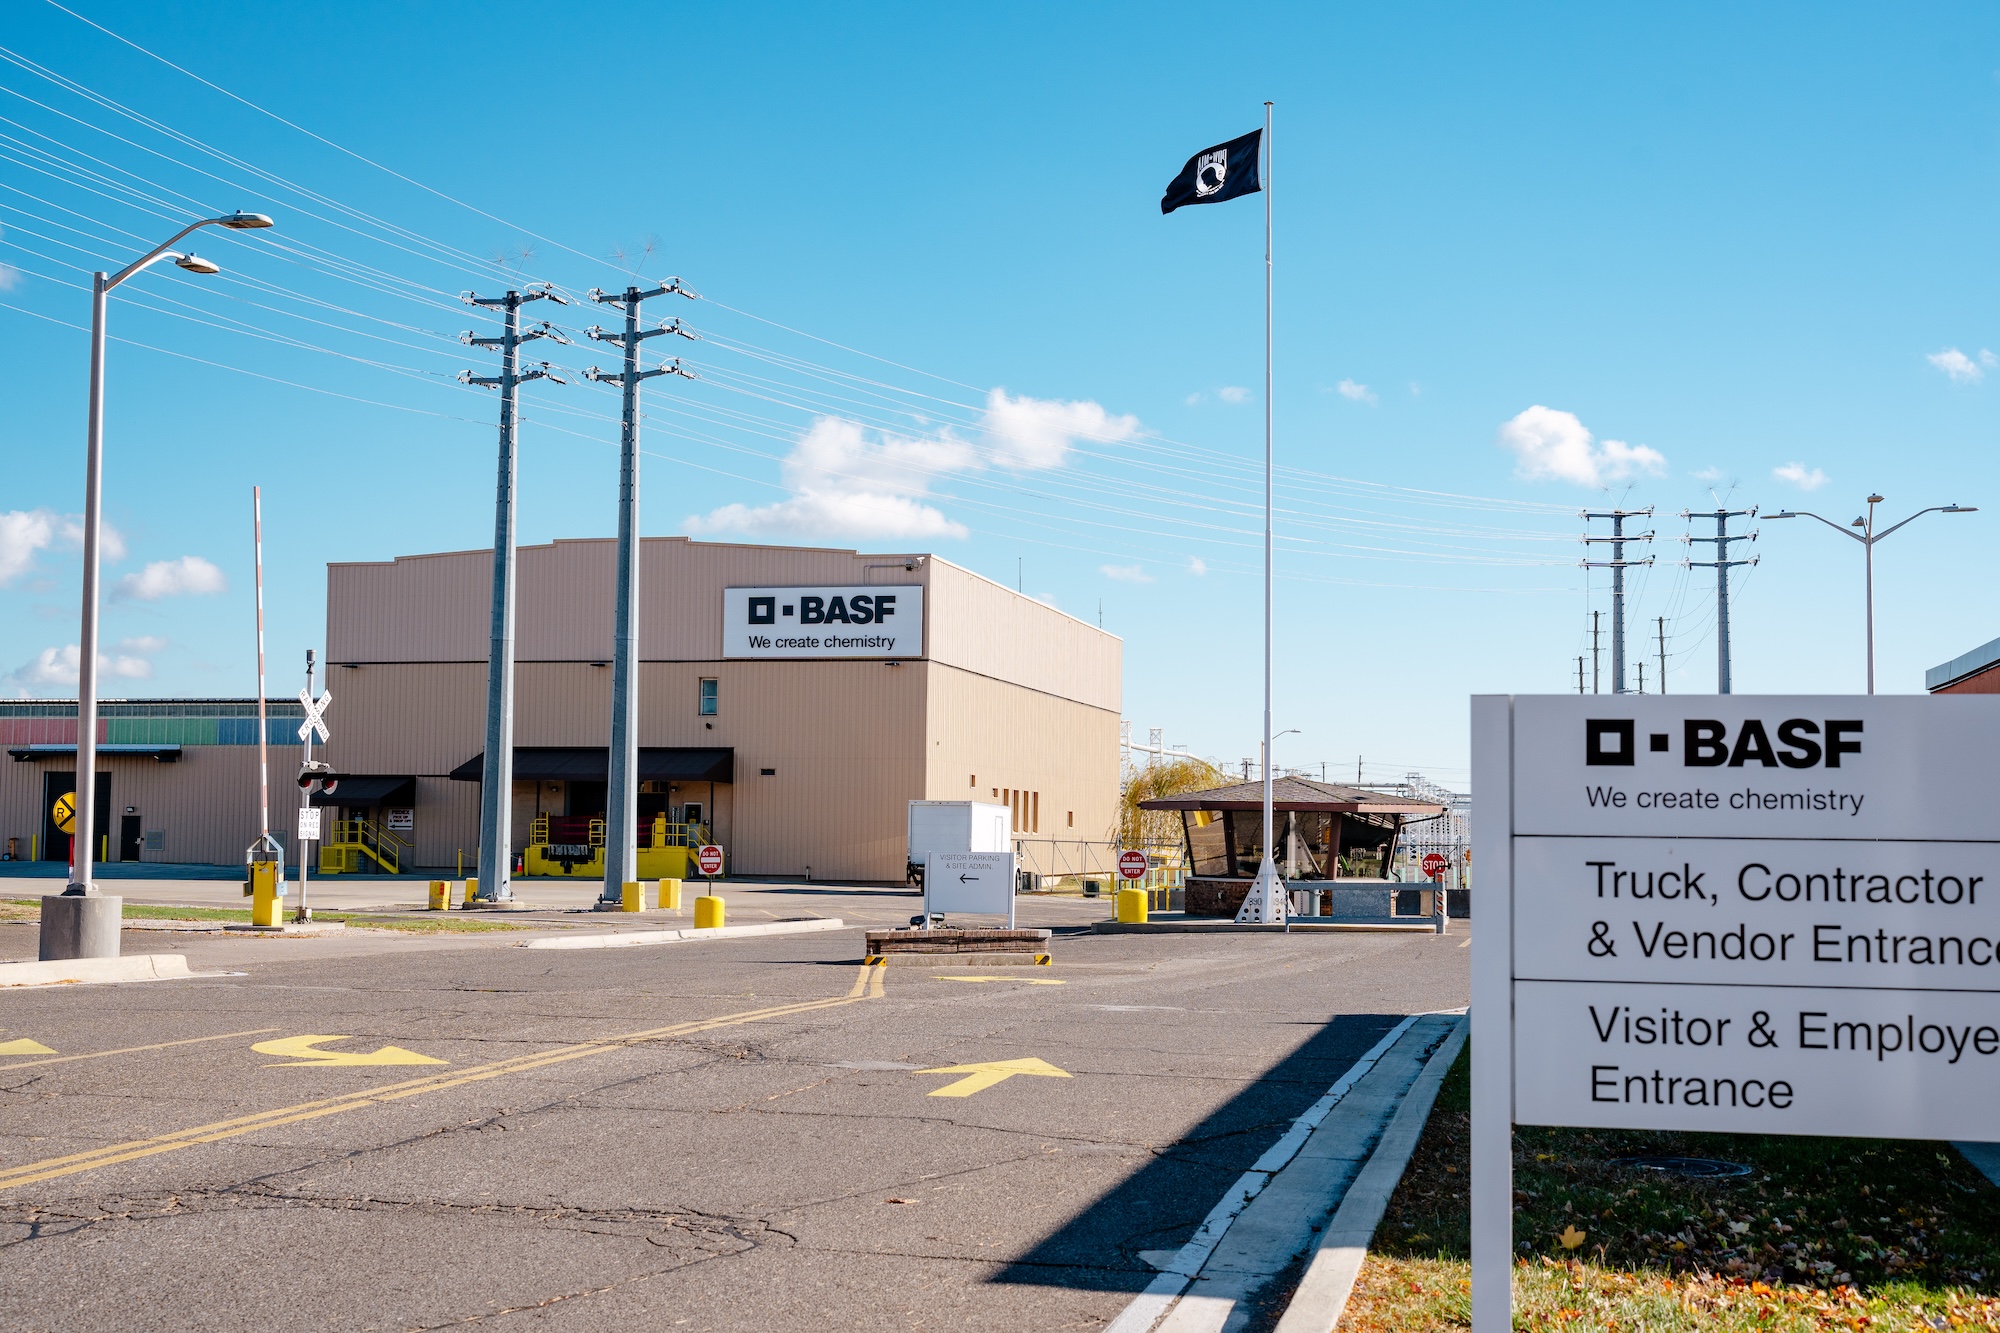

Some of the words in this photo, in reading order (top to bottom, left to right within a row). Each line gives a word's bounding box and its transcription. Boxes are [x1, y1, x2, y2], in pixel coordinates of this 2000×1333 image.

[800, 595, 896, 625] BASF
[748, 636, 771, 649] We
[775, 636, 820, 649] create
[823, 635, 896, 651] chemistry
[1683, 718, 1864, 769] BASF
[56, 807, 65, 818] R
[300, 811, 319, 820] STOP
[1586, 786, 1627, 808] We
[1637, 788, 1719, 809] create
[1729, 788, 1864, 817] chemistry
[1423, 860, 1445, 871] STOP
[1585, 861, 1717, 907] Truck,
[1738, 863, 1984, 905] Contractor
[1587, 920, 1618, 957] &
[1632, 921, 1795, 961] Vendor
[1813, 924, 2000, 966] Entranc
[1588, 1005, 1731, 1046] Visitor
[1747, 1010, 1779, 1048] &
[1591, 1065, 1794, 1109] Entrance
